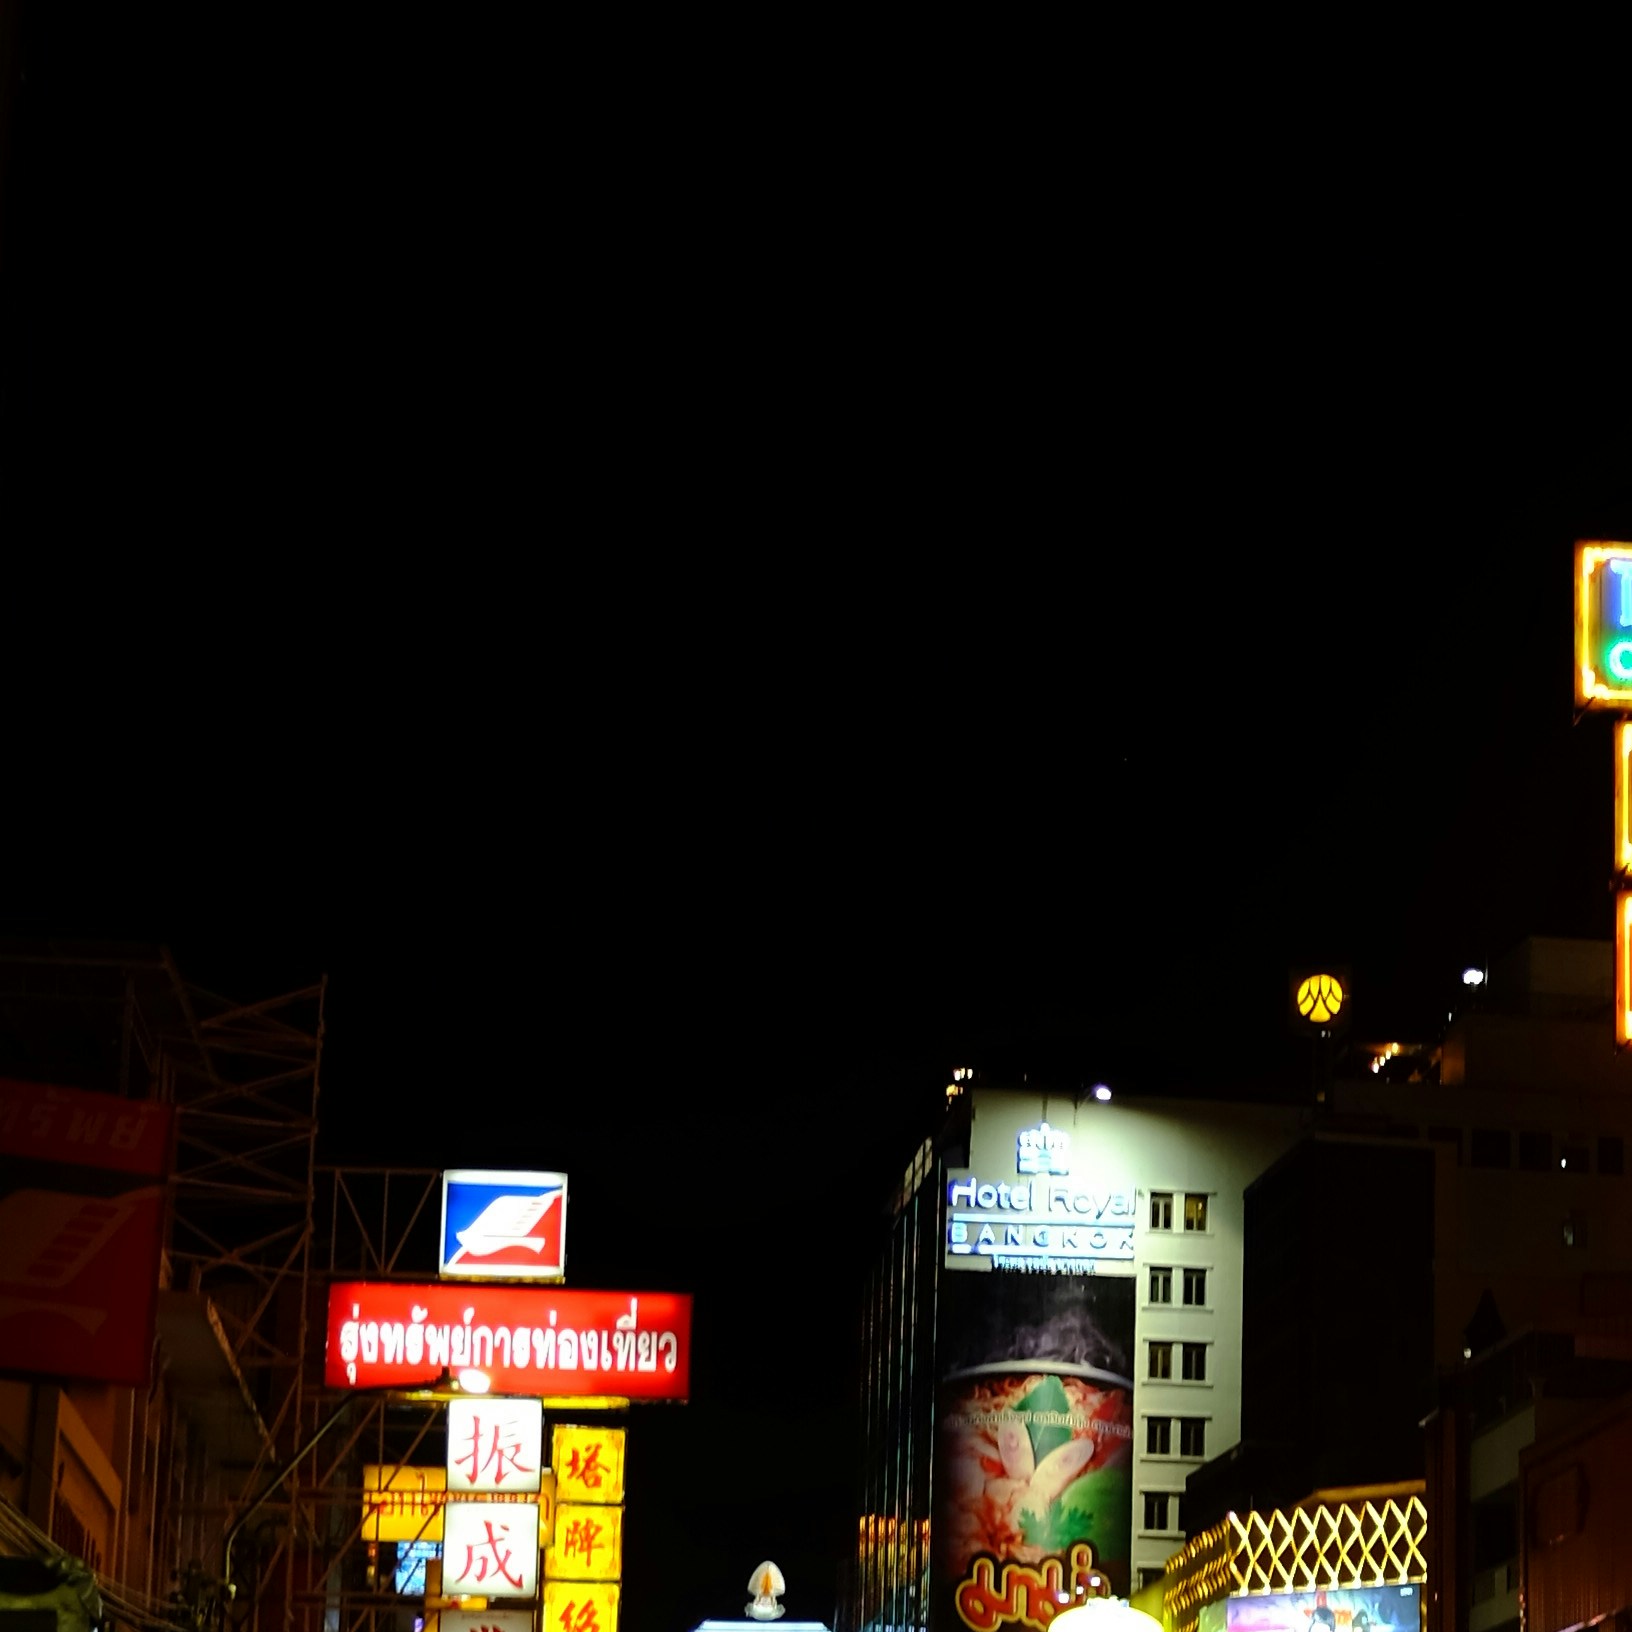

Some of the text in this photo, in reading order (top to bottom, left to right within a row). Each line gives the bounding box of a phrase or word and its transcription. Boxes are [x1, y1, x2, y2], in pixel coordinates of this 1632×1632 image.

[949, 1177, 1136, 1220] Hotel Royal
[949, 1223, 1134, 1249] BANGKOK
[339, 1298, 678, 1384] รุ่งทรัพย์การท่องเที่ยว
